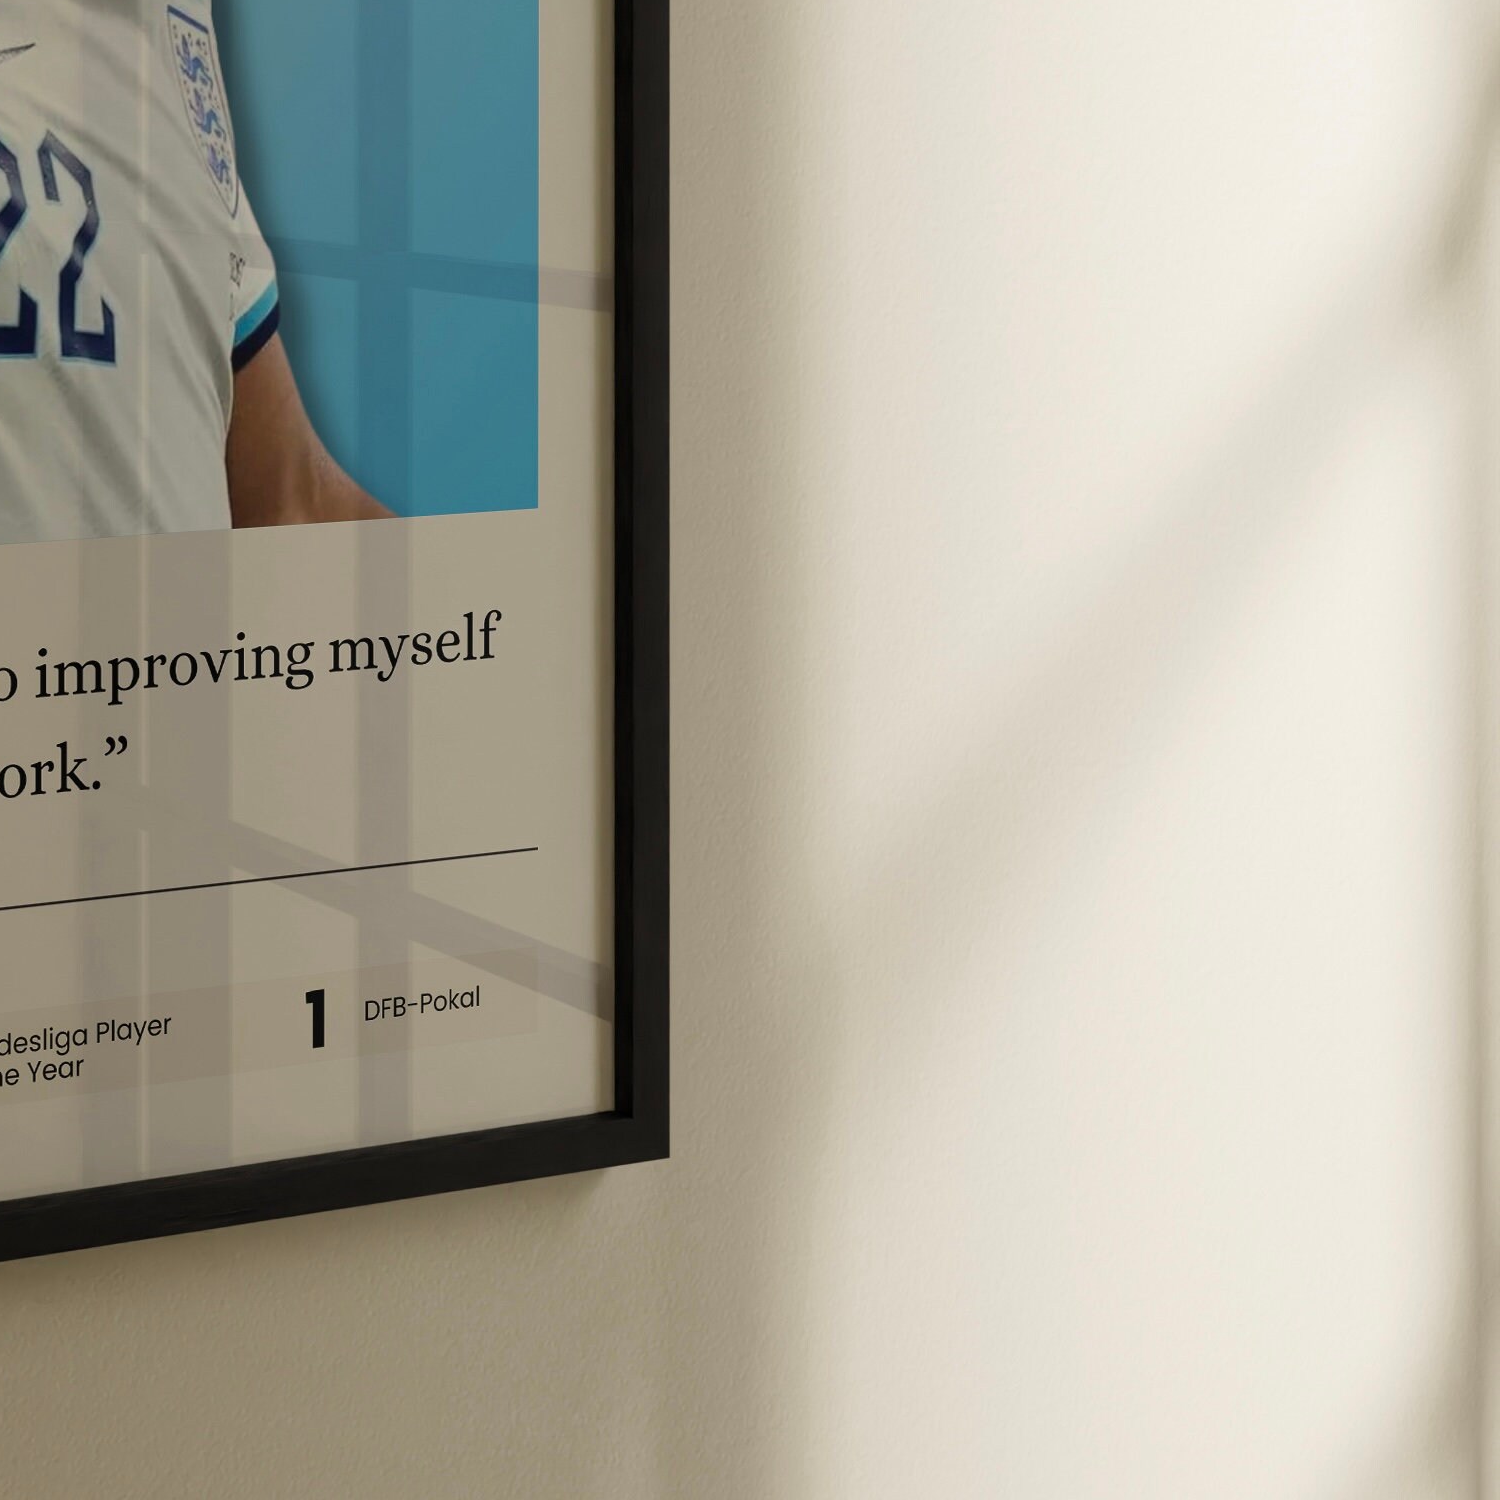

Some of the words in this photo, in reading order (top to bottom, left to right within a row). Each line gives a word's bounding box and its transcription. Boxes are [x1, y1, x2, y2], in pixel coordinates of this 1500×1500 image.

[35, 631, 315, 706] improving
[328, 609, 502, 683] myself
[305, 988, 325, 1049] 1
[364, 985, 480, 1022] DFB-Pokal
[96, 1017, 172, 1046] Player
[27, 1059, 85, 1083] Year
